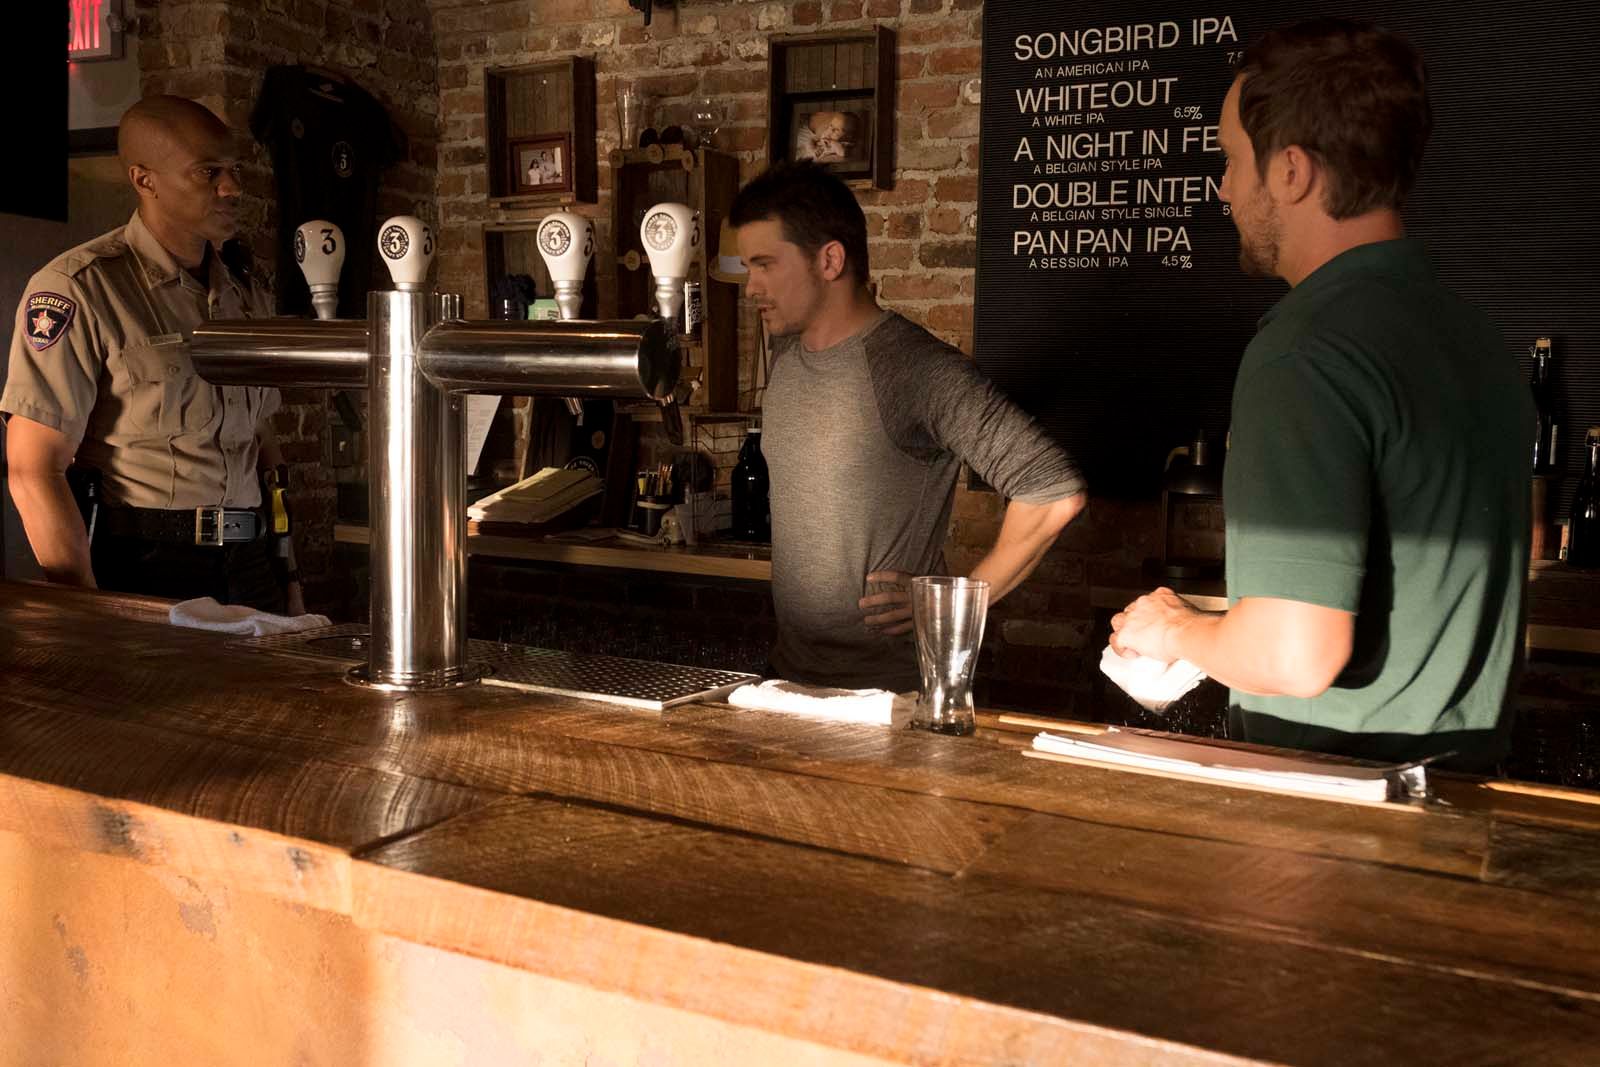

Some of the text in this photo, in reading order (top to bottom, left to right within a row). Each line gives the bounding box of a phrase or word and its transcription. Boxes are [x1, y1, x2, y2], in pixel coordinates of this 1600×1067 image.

[69, 0, 103, 50] XIT
[1014, 15, 1238, 61] SONGBIRD IPA
[1034, 58, 1150, 79] AN AMERICAN IPA
[1015, 77, 1179, 114] WHITEOUT
[1032, 112, 1105, 127] A WHITE IPA
[1173, 105, 1203, 120] 6.5%
[1014, 137, 1034, 162] A
[1046, 130, 1134, 161] NIGHT
[1142, 128, 1168, 155] IN
[1033, 158, 1163, 175] A BELGIAN STYLE IPA
[1013, 179, 1129, 209] DOUBLE
[1030, 206, 1193, 222] A BELGIAN STYLE SINGLE
[320, 228, 337, 255] 3
[390, 232, 401, 253] 3
[1013, 225, 1193, 256] PAN PAN IPA
[1029, 256, 1129, 269] A SESSION IPA
[1161, 255, 1193, 270] 4.5%
[30, 296, 71, 311] SHERIFF
